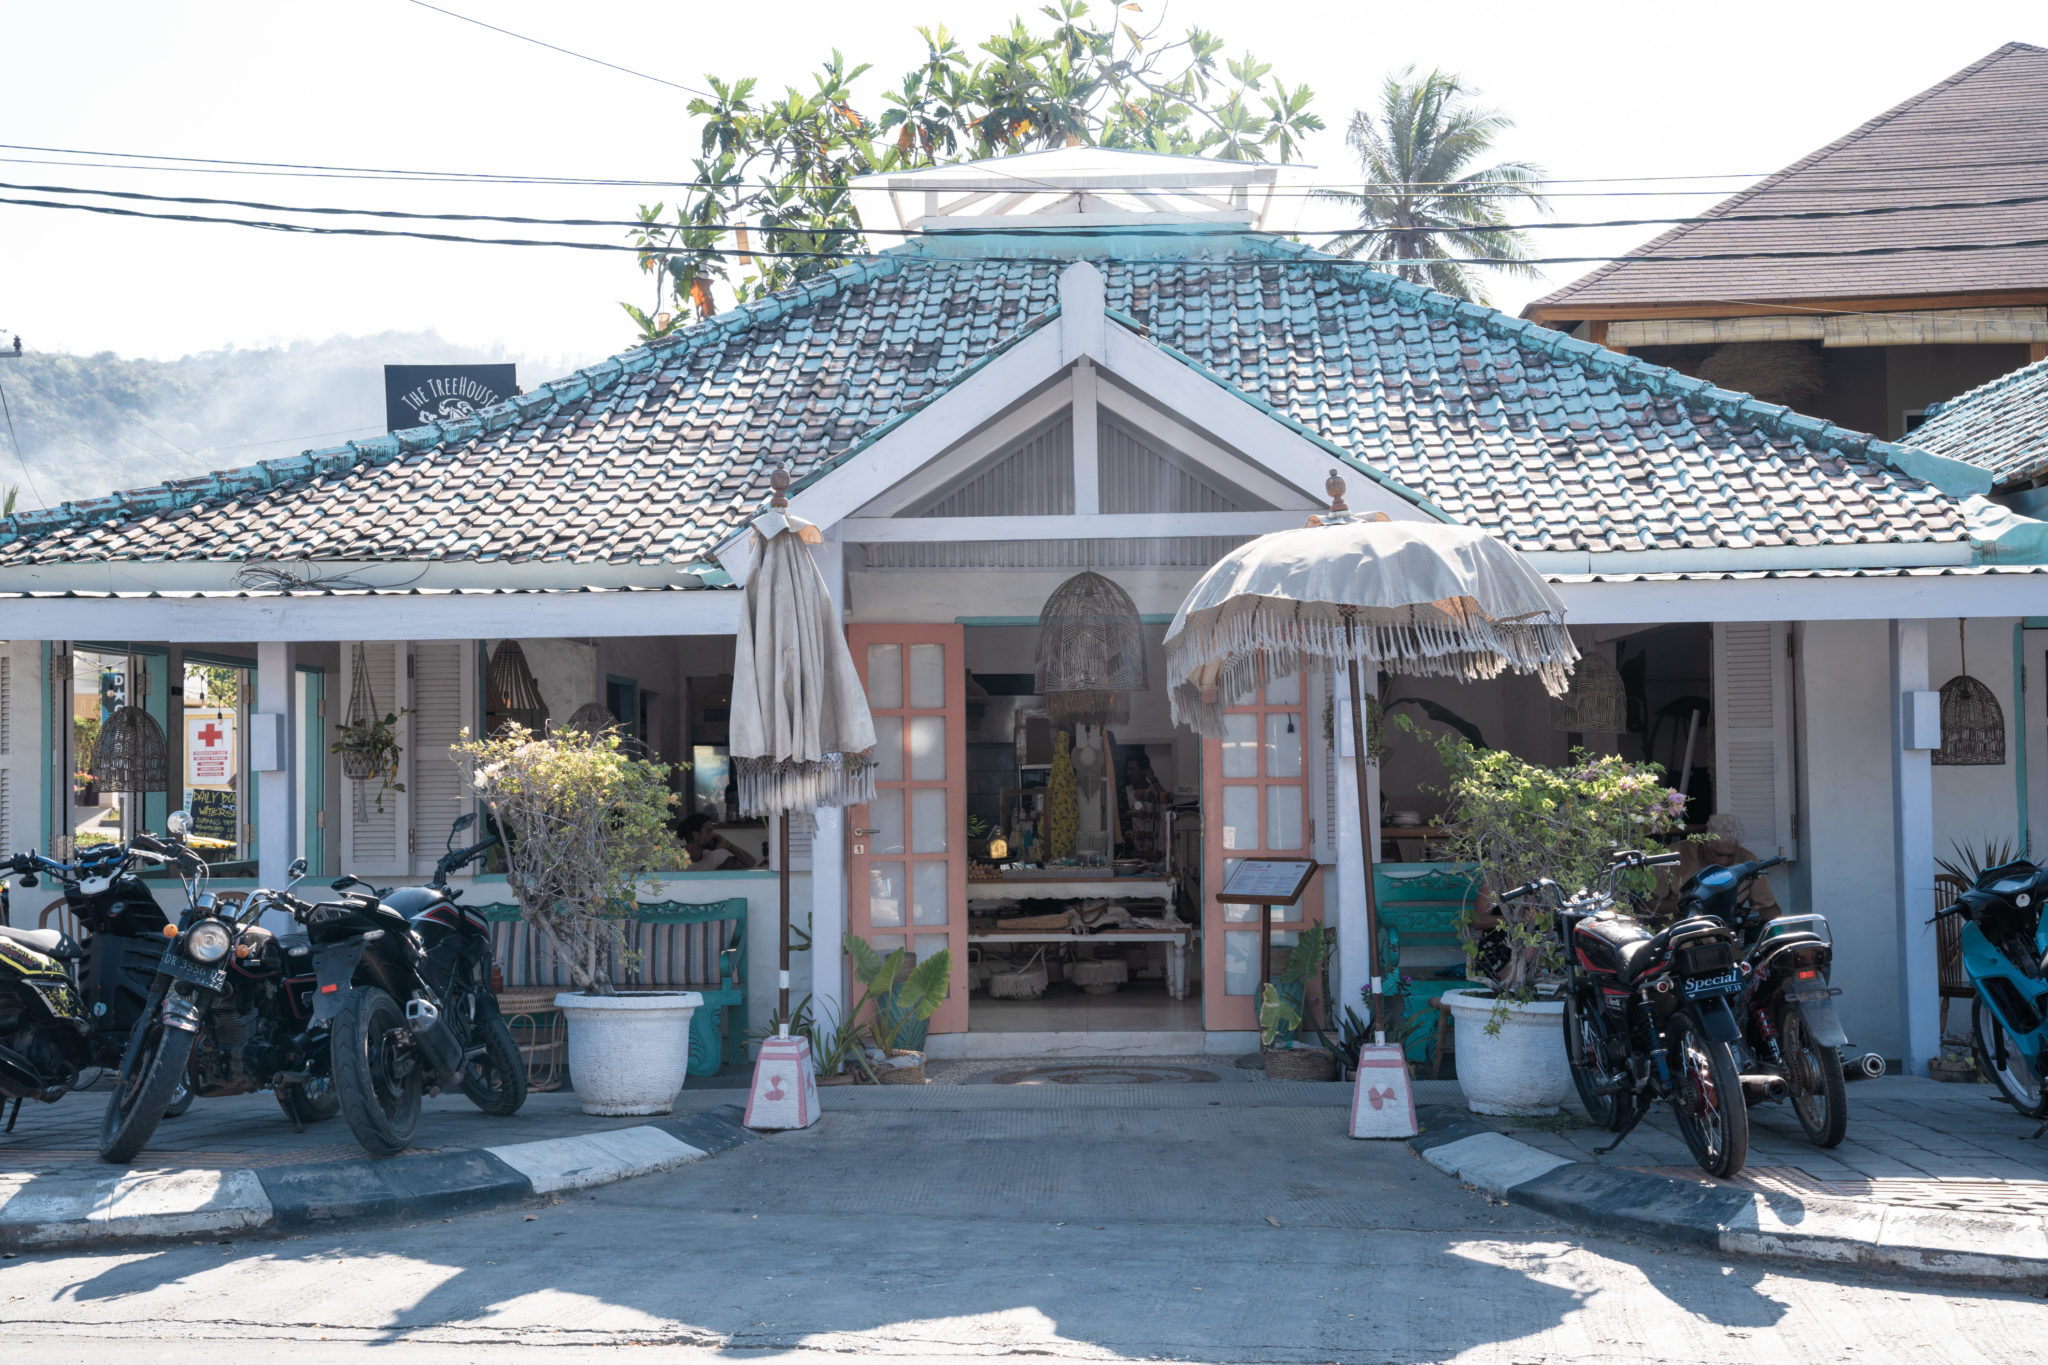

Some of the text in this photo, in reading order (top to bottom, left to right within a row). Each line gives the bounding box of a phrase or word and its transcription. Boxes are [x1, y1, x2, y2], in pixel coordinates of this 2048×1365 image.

[401, 387, 429, 410] THE
[193, 791, 219, 804] DAILY
[164, 953, 178, 966] DR
[1685, 970, 1737, 991] Special
